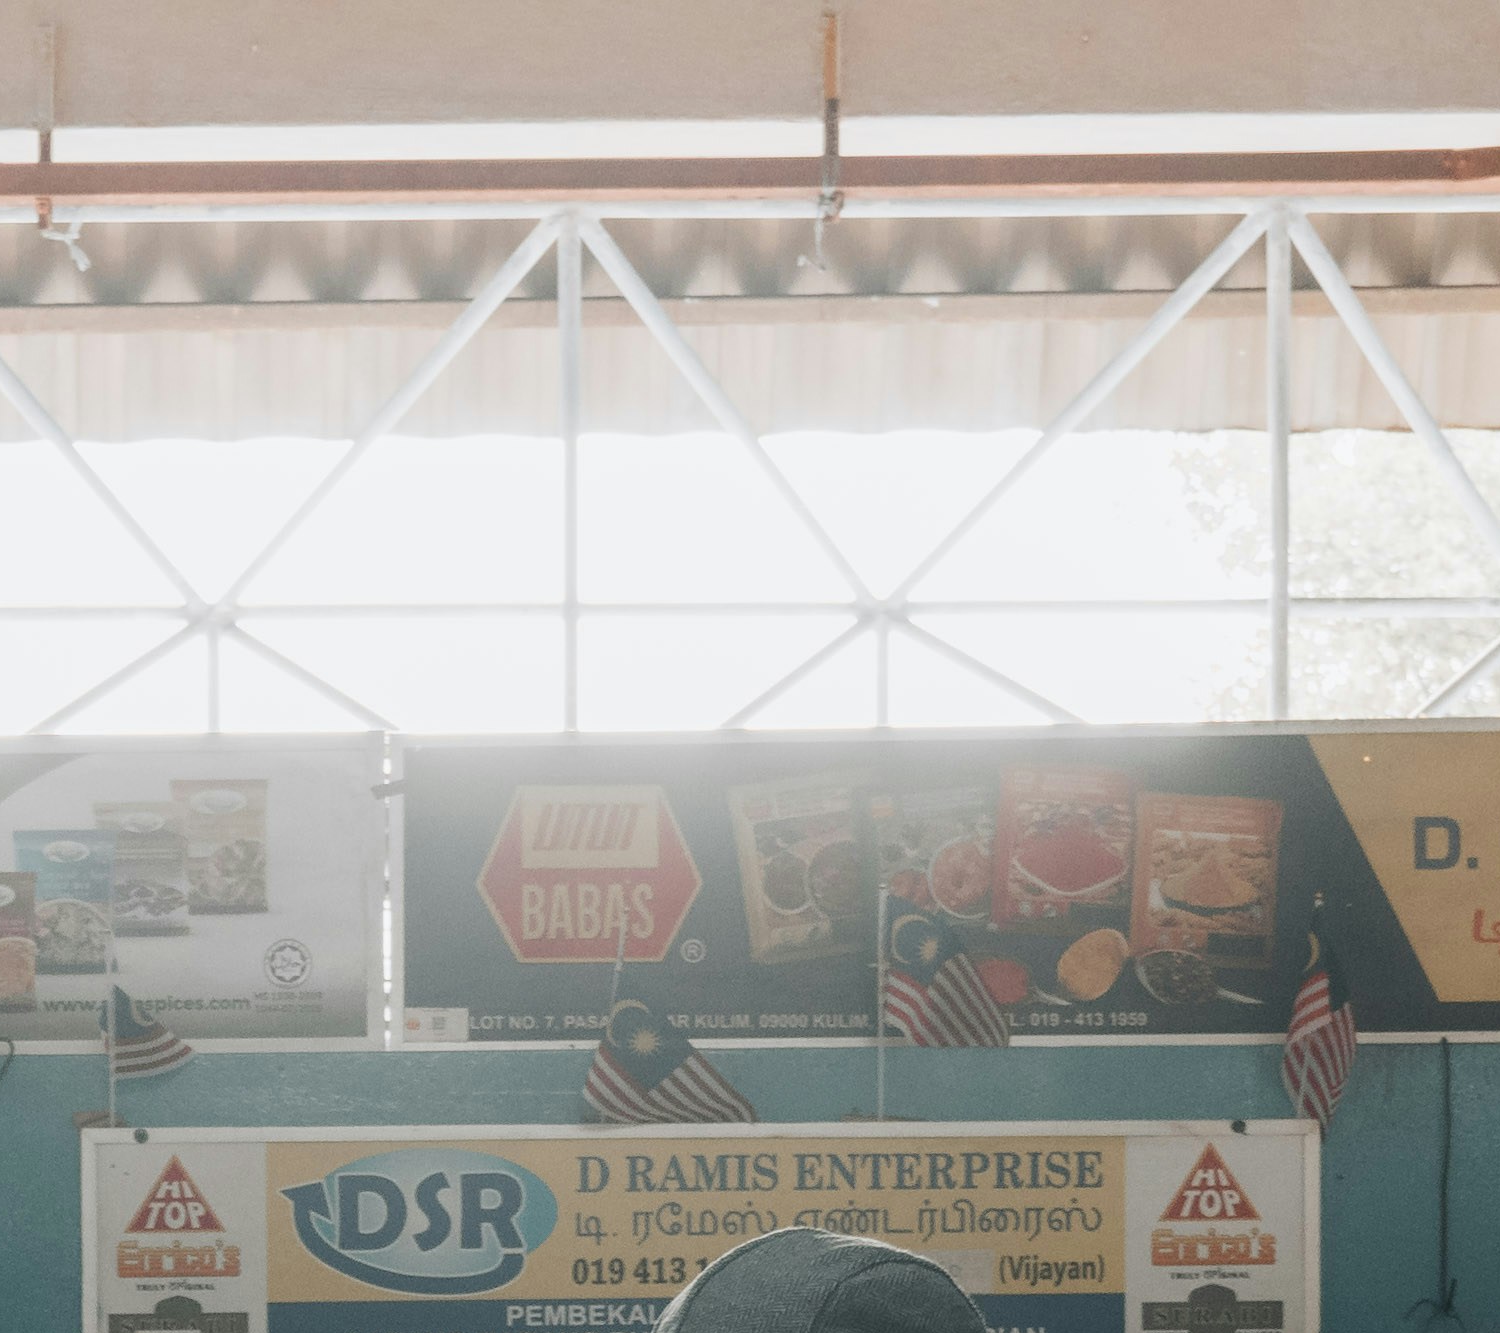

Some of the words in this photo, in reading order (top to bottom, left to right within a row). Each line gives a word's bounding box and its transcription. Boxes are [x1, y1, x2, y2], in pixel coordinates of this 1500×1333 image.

[1413, 815, 1478, 872] D.
[759, 1012, 808, 1028] 09000
[1030, 1013, 1060, 1026] 019
[1074, 1012, 1104, 1026] 413
[576, 1156, 609, 1192] D
[625, 1154, 779, 1191] RAMIS
[793, 1151, 1104, 1190] ENTERPRISE
[1191, 1169, 1231, 1187] HI
[156, 1181, 194, 1199] HI
[1180, 1189, 1241, 1218] TOP
[145, 1200, 206, 1229] TOP
[336, 1171, 526, 1253] DSR
[571, 1257, 626, 1285] 019
[632, 1257, 688, 1284] 413
[998, 1254, 1106, 1286] (Vijayan)
